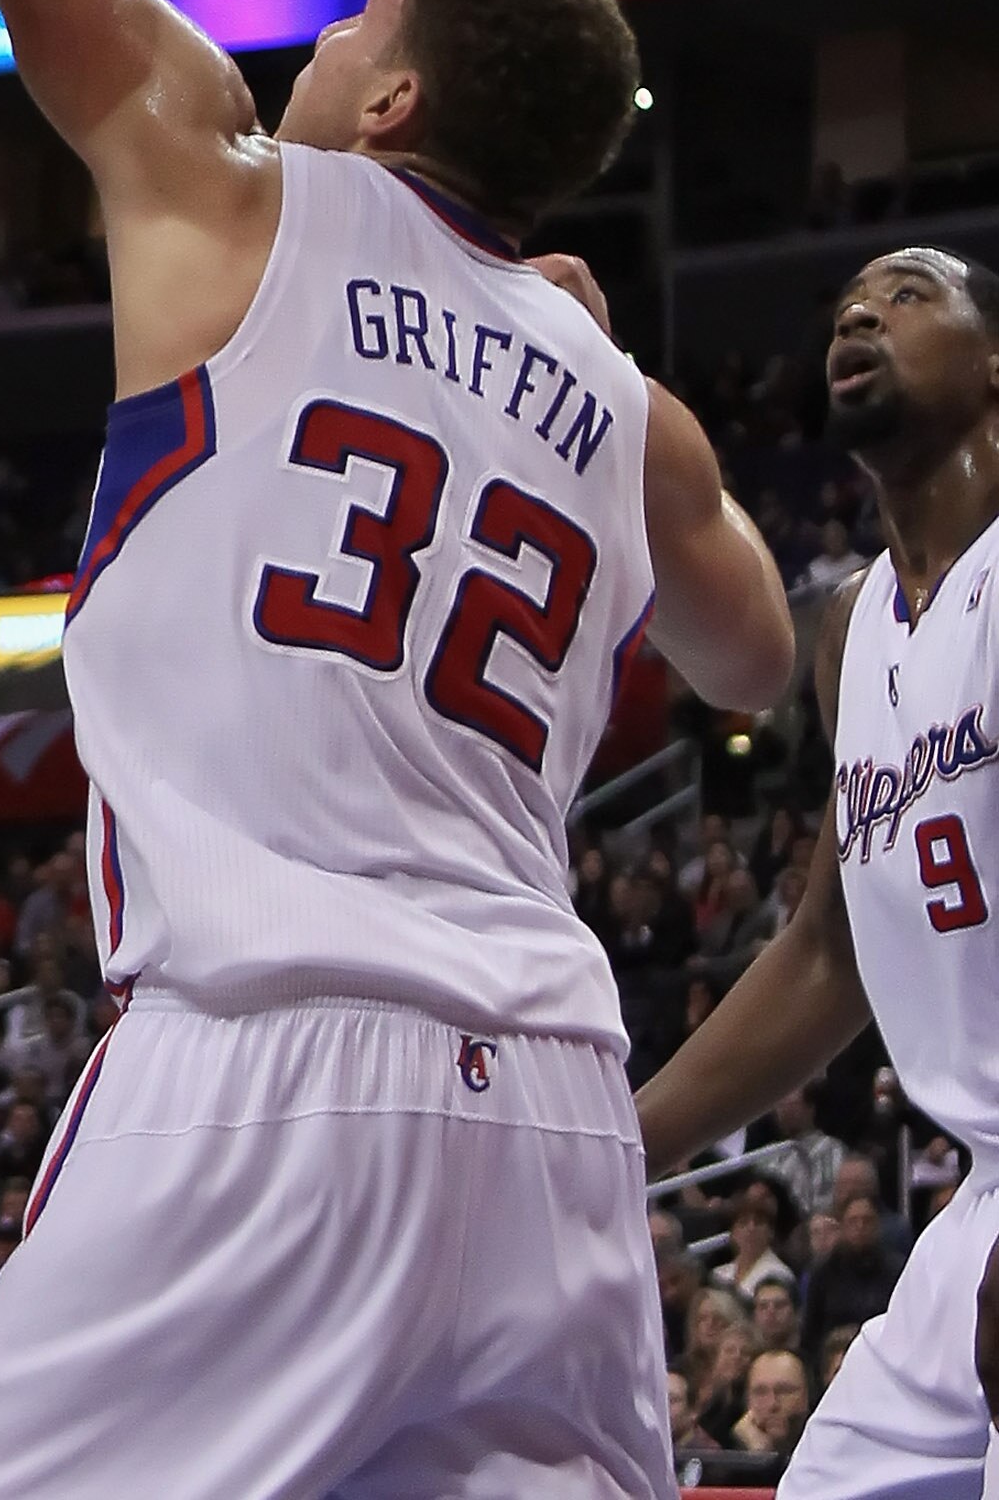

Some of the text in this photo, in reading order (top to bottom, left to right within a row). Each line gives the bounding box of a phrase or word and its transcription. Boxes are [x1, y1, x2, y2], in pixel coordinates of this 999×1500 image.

[345, 278, 614, 476] GRIFFIN
[252, 397, 599, 776] 32
[914, 812, 989, 934] 9
